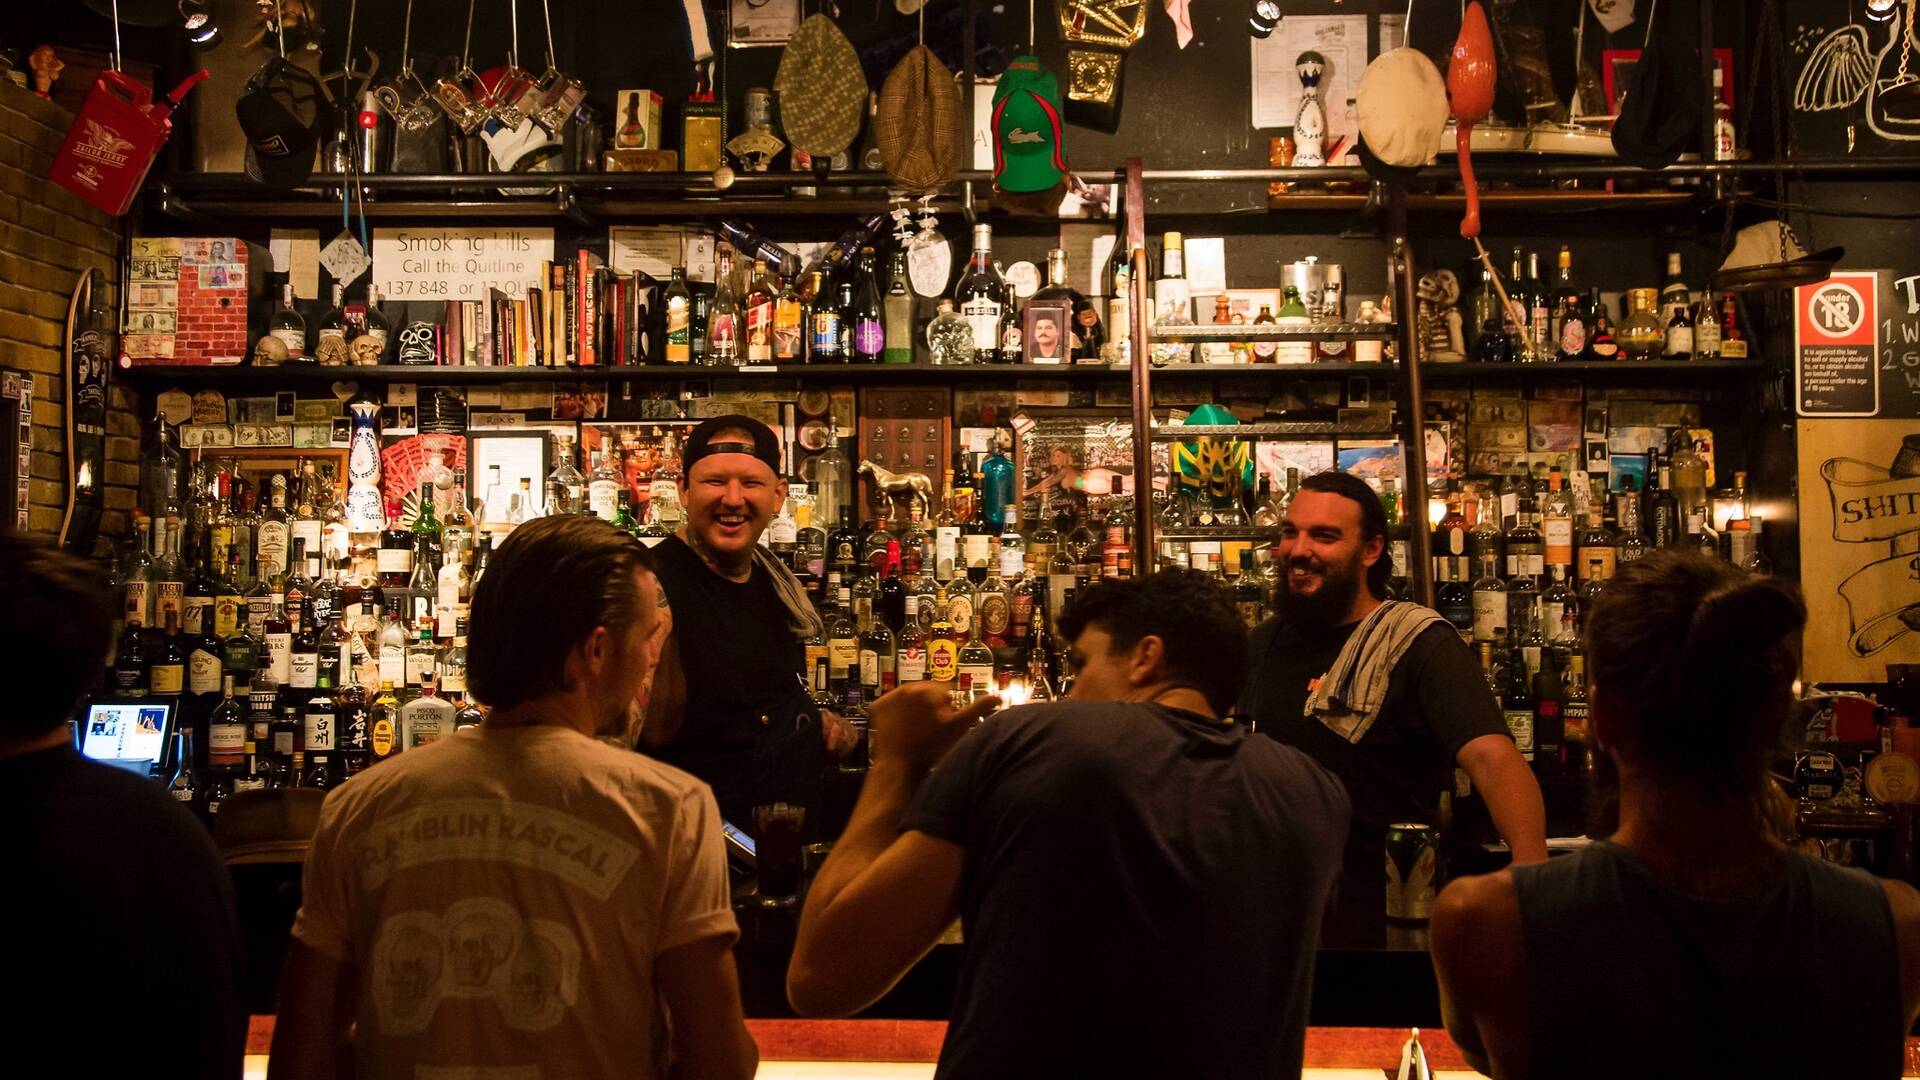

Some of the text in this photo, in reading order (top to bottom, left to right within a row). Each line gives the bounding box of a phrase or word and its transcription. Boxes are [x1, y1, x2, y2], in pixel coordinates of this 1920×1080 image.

[397, 232, 484, 256] Smokng
[403, 259, 525, 274] Call the Quitline
[387, 281, 413, 295] 137
[420, 281, 448, 295] 848
[459, 284, 474, 295] or
[315, 718, 328, 746] 白州
